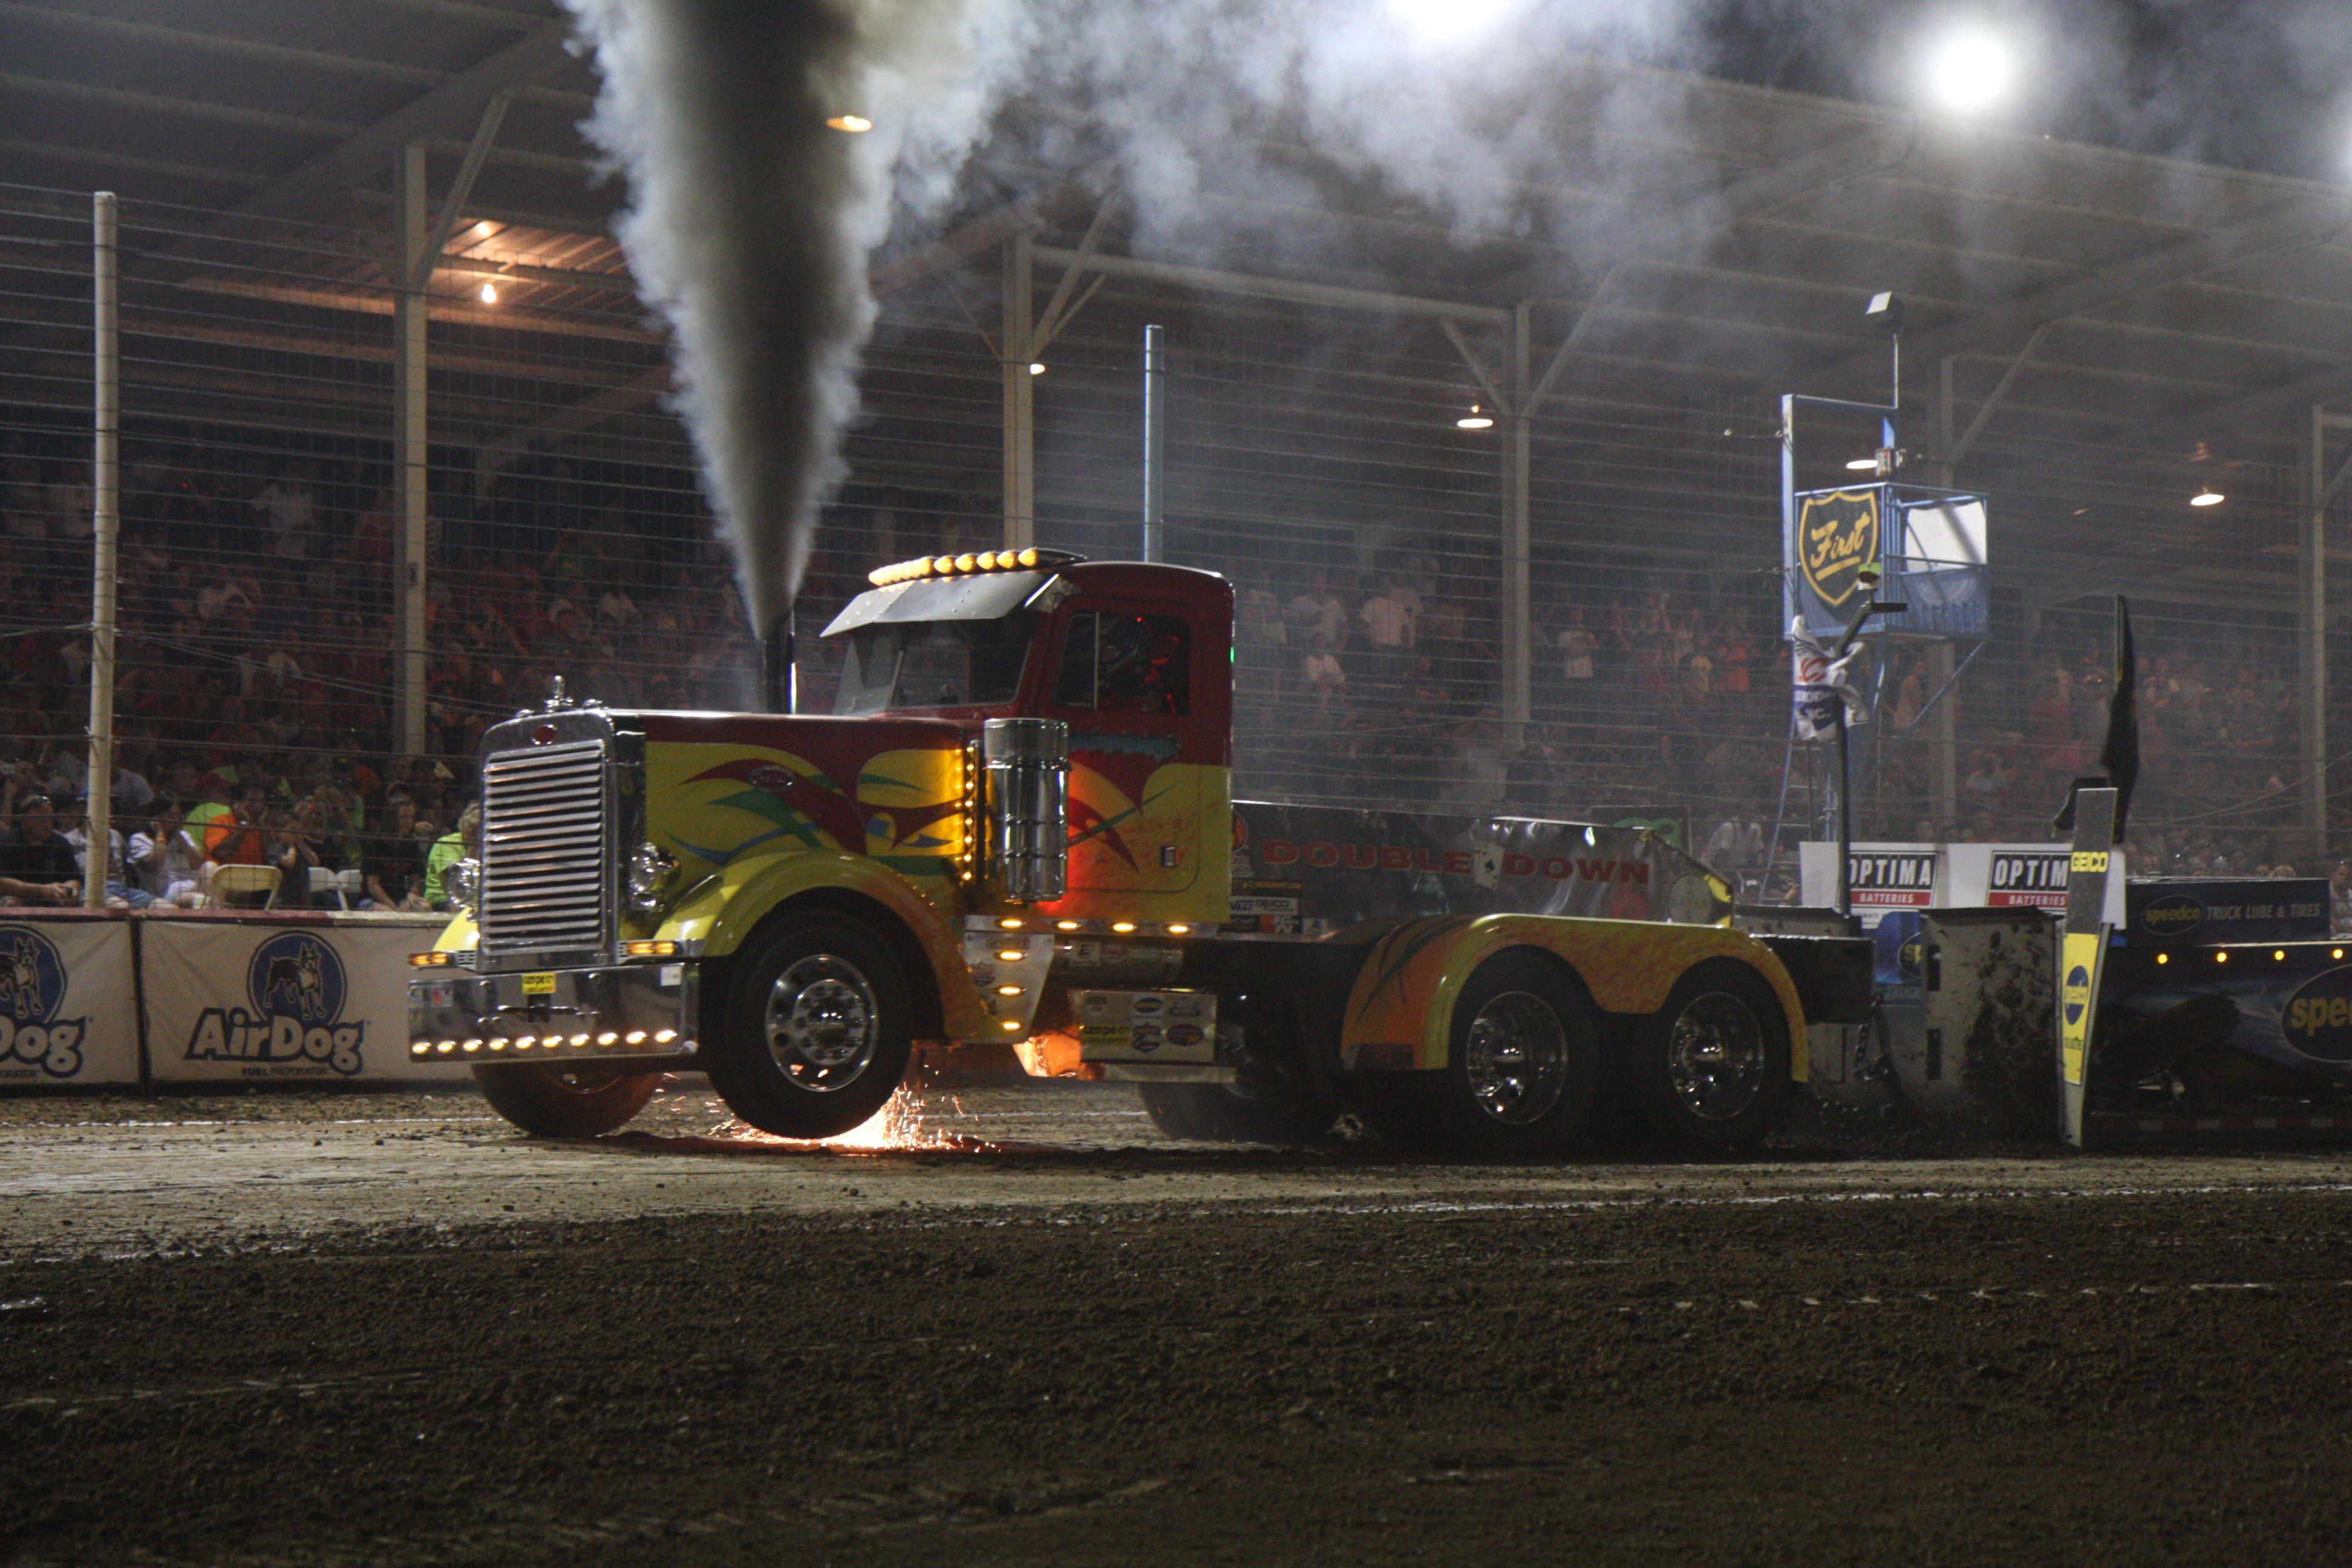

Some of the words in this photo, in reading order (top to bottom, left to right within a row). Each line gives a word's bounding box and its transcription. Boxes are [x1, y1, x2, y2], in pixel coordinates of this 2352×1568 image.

[1811, 511, 1871, 568] First
[1263, 838, 1472, 875] DOUBLE
[1503, 851, 1650, 886] DOWN
[1994, 859, 2070, 887] OPTIM
[2071, 852, 2109, 872] GEICO
[1860, 893, 1914, 904] BATTERIES
[2009, 895, 2066, 906] BATTERIES
[2146, 904, 2201, 926] speedco
[2206, 906, 2241, 920] TRUCK
[2245, 904, 2273, 918] LUBE
[2276, 904, 2285, 918] &
[2290, 903, 2321, 917] TIRES
[2290, 997, 2352, 1036] spe
[184, 1007, 364, 1076] AirDog
[242, 1067, 269, 1076] FUEL
